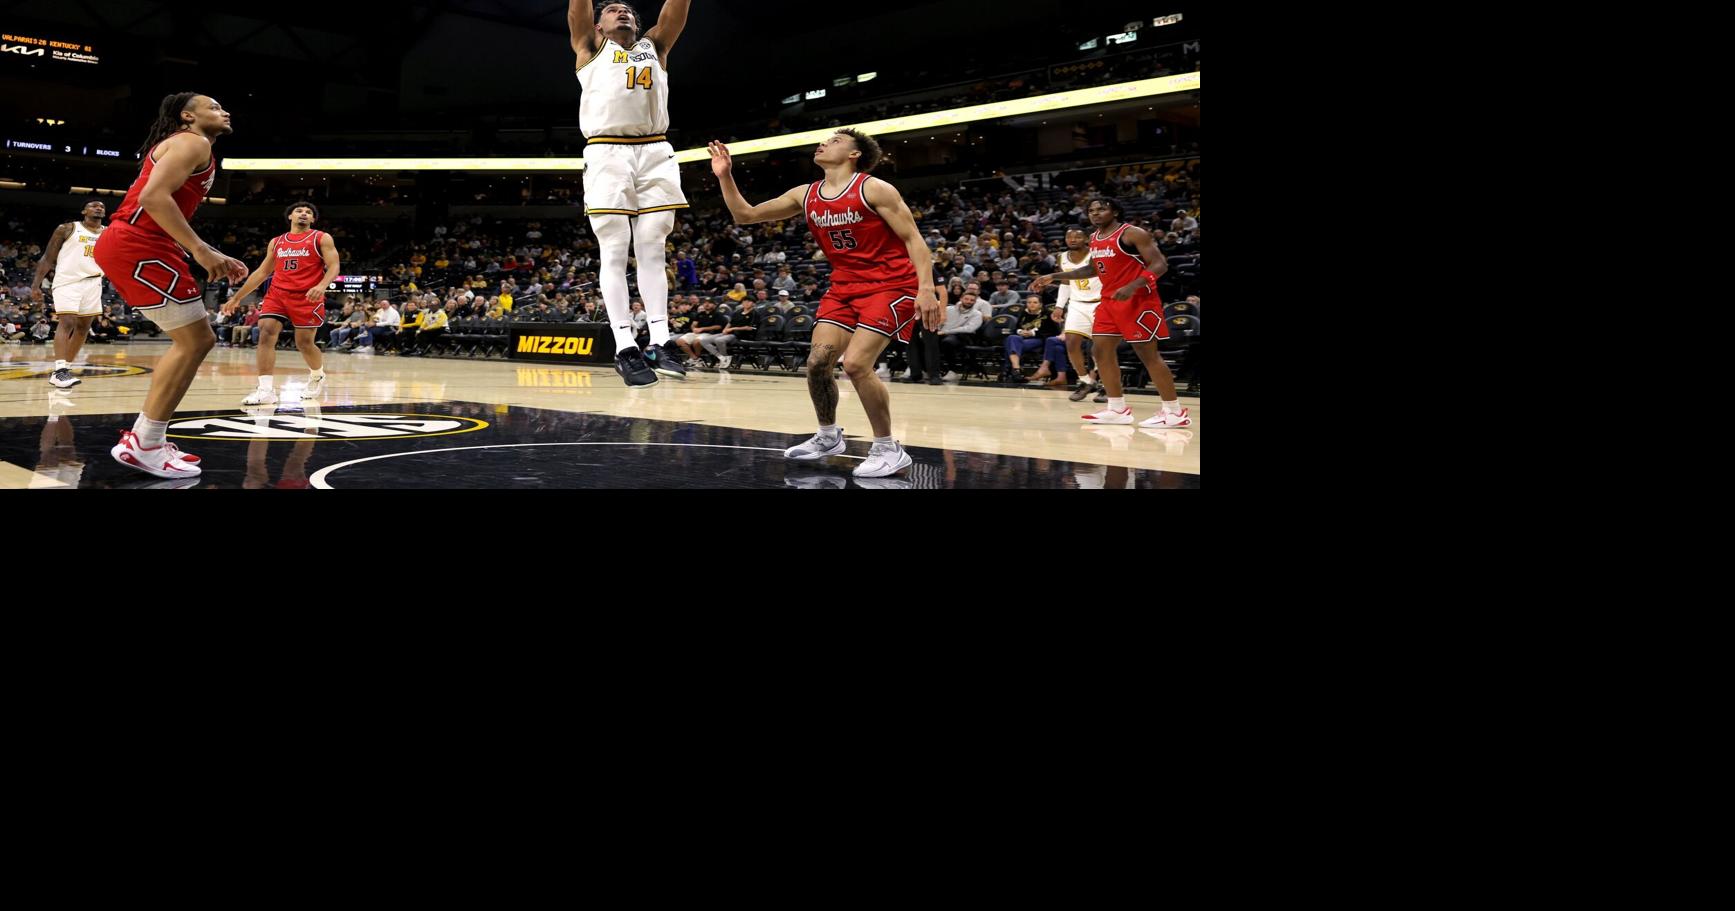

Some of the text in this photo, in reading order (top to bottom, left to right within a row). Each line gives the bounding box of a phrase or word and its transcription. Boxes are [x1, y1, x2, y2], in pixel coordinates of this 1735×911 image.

[49, 40, 80, 50] KENTUCKY
[625, 66, 653, 89] 14
[13, 141, 71, 153] TURNOVERS 3
[810, 207, 864, 228] Redhawks
[828, 229, 857, 250] 55
[276, 247, 310, 258] Redhawks
[284, 259, 298, 270] 15
[517, 335, 594, 355] MIZZOU
